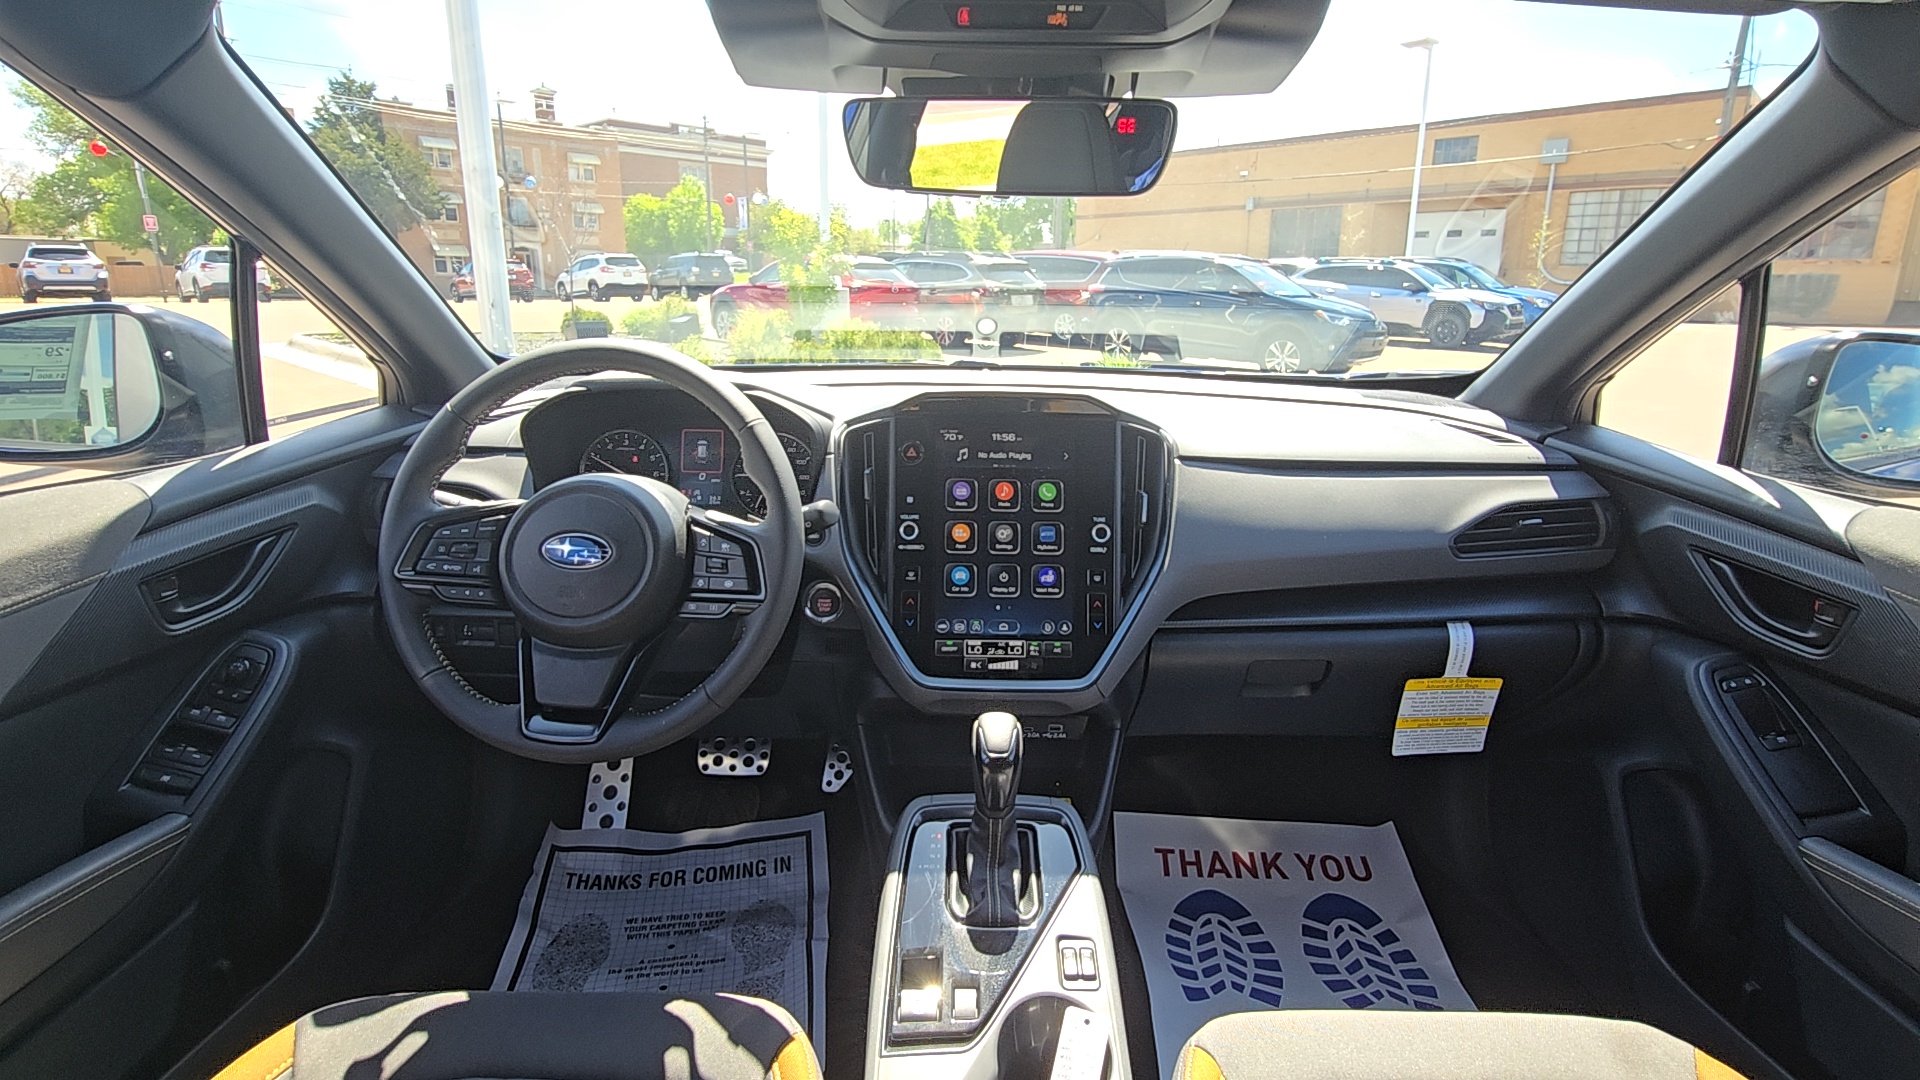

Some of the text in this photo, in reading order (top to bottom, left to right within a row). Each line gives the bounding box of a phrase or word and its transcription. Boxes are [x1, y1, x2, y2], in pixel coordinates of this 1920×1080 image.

[991, 432, 1016, 442] 11:56
[977, 451, 1032, 461] No Audio Playing
[967, 645, 983, 654] LO
[1007, 646, 1022, 655] LO
[1153, 847, 1373, 882] THANK YOU
[565, 855, 792, 891] THANKS FOR COMING IN
[625, 910, 727, 925] WE HAVE TRIED TO KEEP
[623, 918, 726, 933] YOUR CARPETING CLEAN
[626, 932, 650, 941] WITH
[651, 930, 671, 938] THIS
[673, 928, 700, 937] PAPER
[695, 957, 726, 967] person
